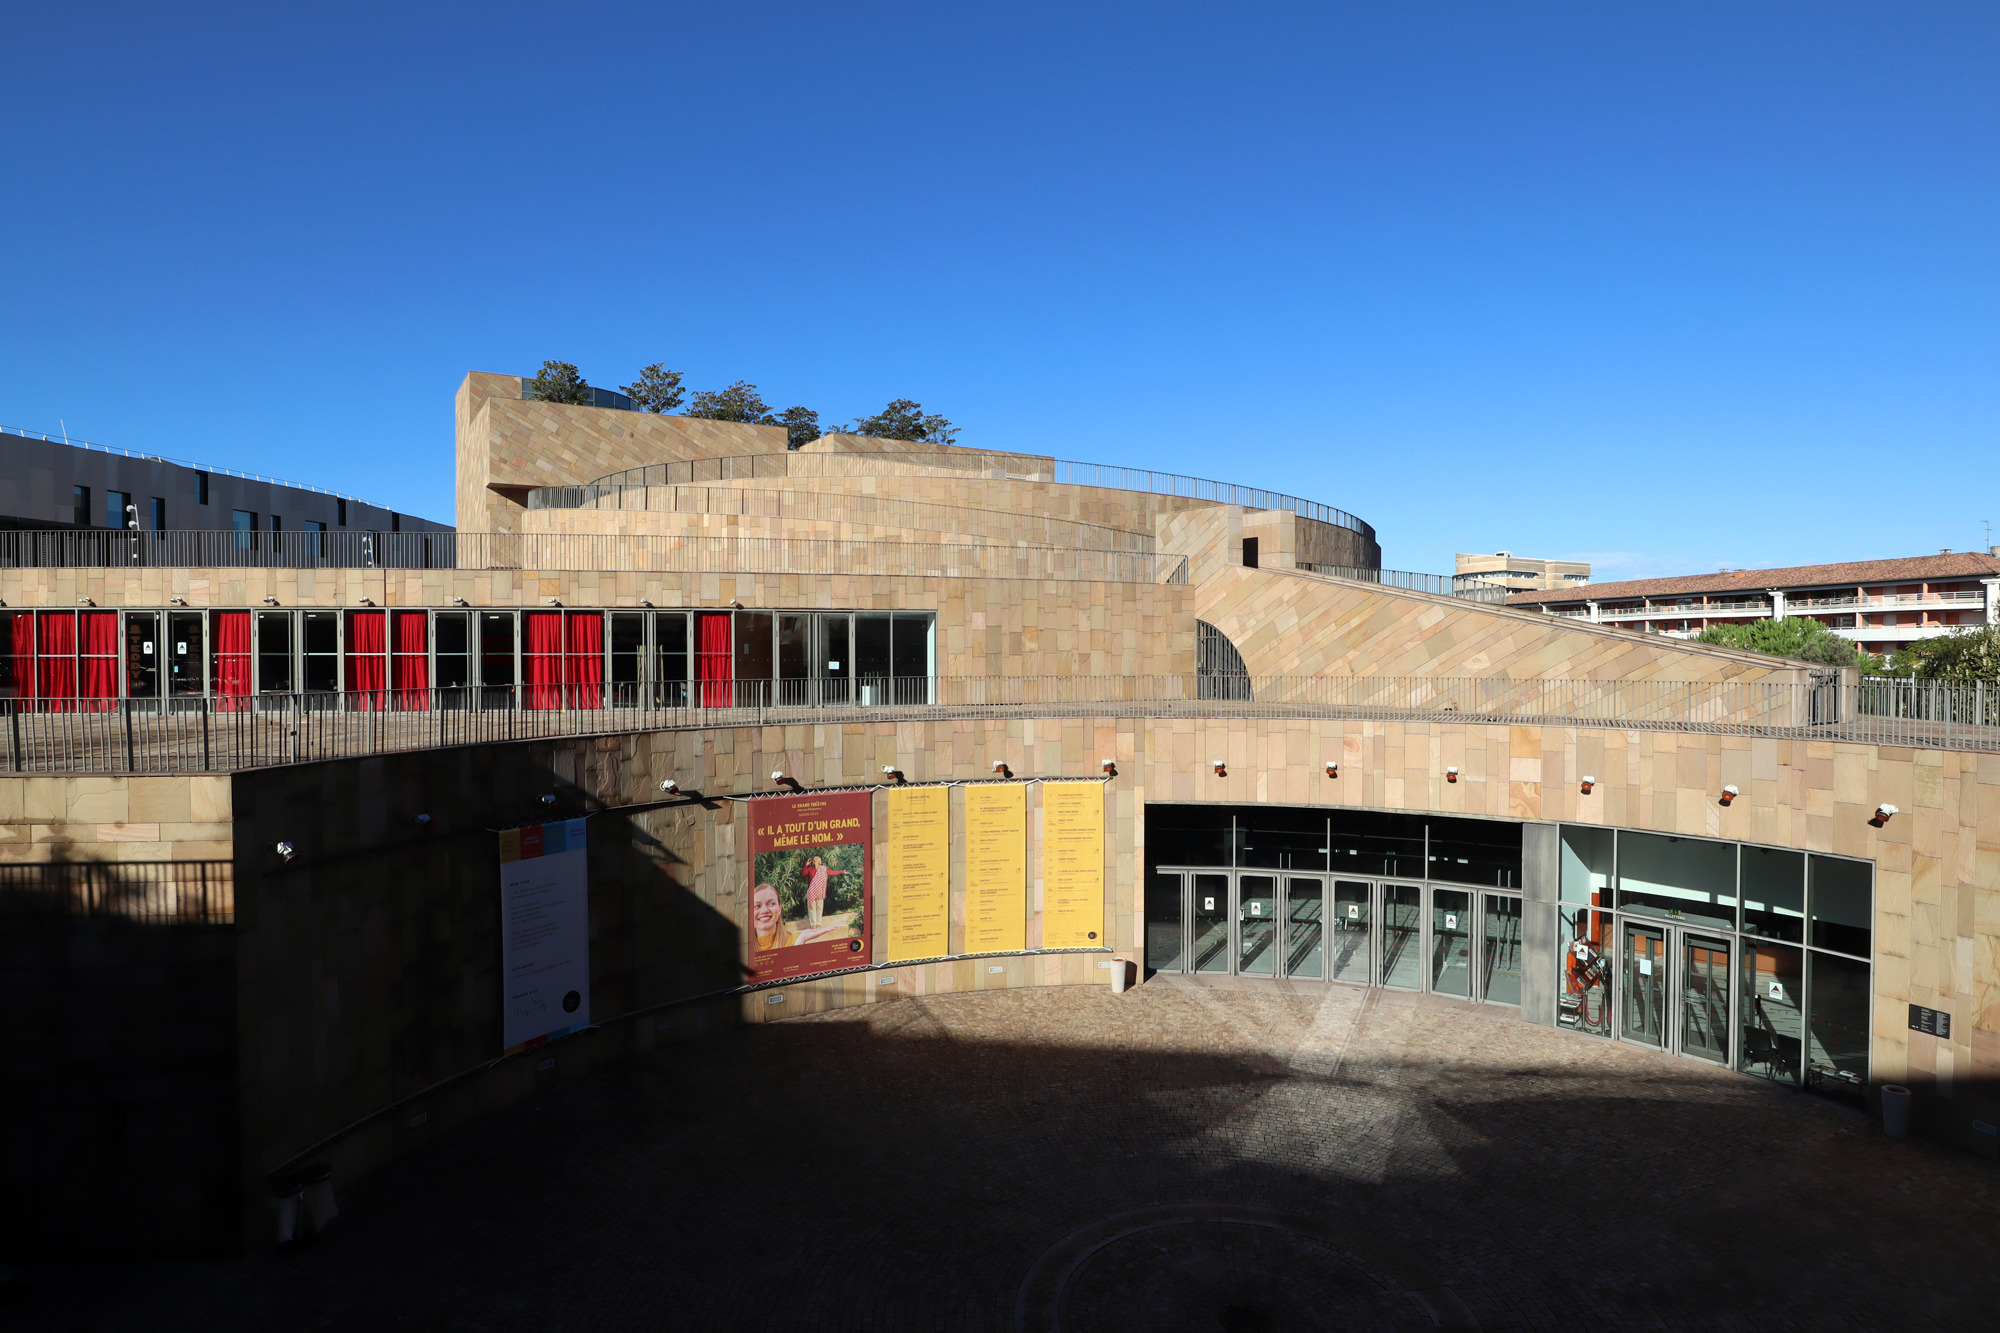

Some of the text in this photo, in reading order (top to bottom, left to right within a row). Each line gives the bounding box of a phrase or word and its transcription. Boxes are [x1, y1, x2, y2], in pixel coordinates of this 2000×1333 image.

[130, 635, 142, 679] TEDDY
[767, 825, 775, 835] IL
[776, 824, 783, 835] A
[784, 822, 806, 833] TOUT
[807, 820, 828, 832] D'UN
[829, 817, 861, 829] GRAND,
[773, 834, 799, 848] MÊME
[800, 834, 810, 844] LE
[811, 832, 834, 843] NOM.
